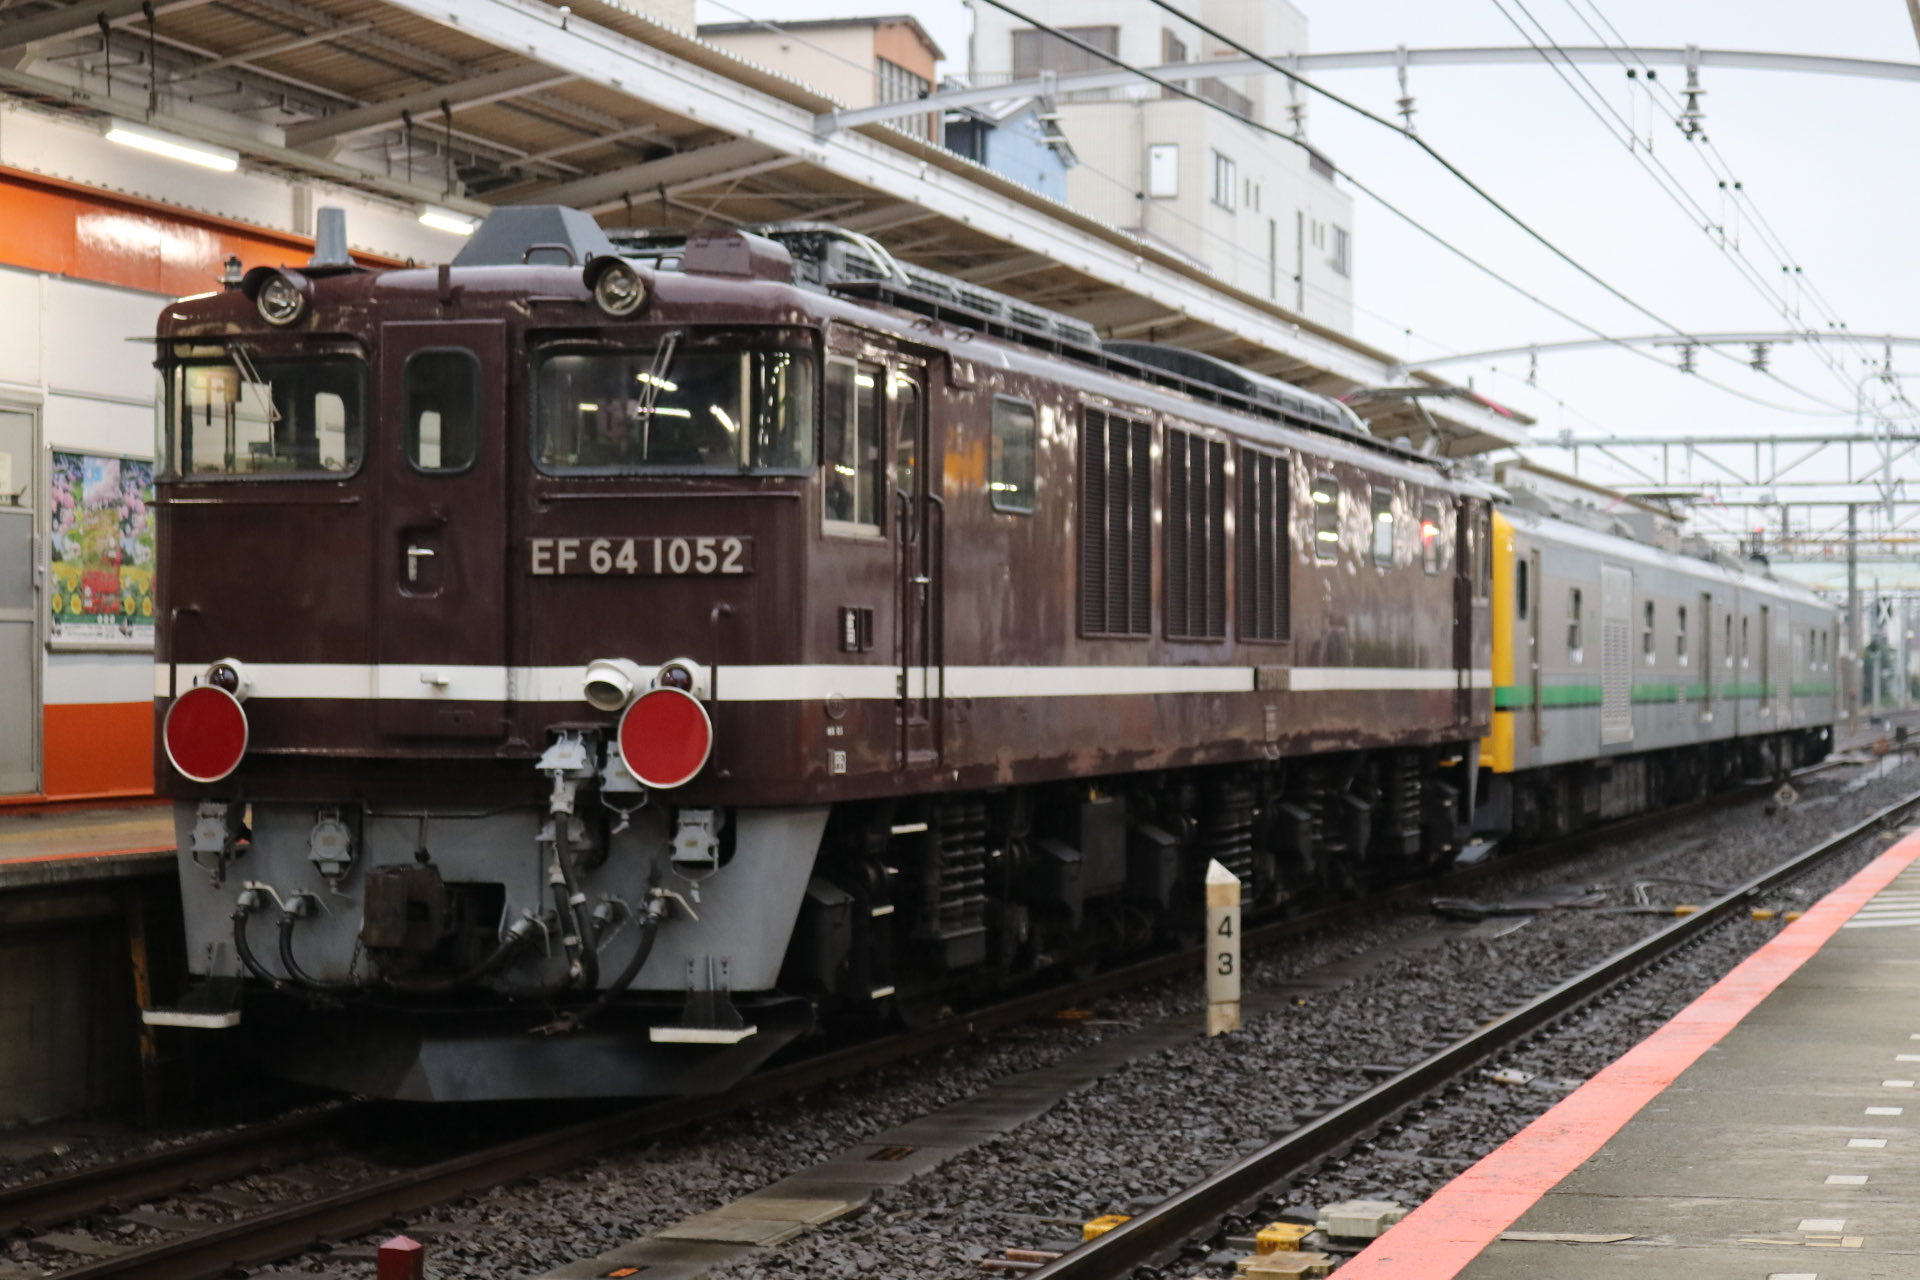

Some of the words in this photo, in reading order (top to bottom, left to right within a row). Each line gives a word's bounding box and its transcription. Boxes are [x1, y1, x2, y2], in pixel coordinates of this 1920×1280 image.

[532, 538, 580, 574] EF
[590, 537, 638, 574] 64
[654, 537, 744, 574] 1052
